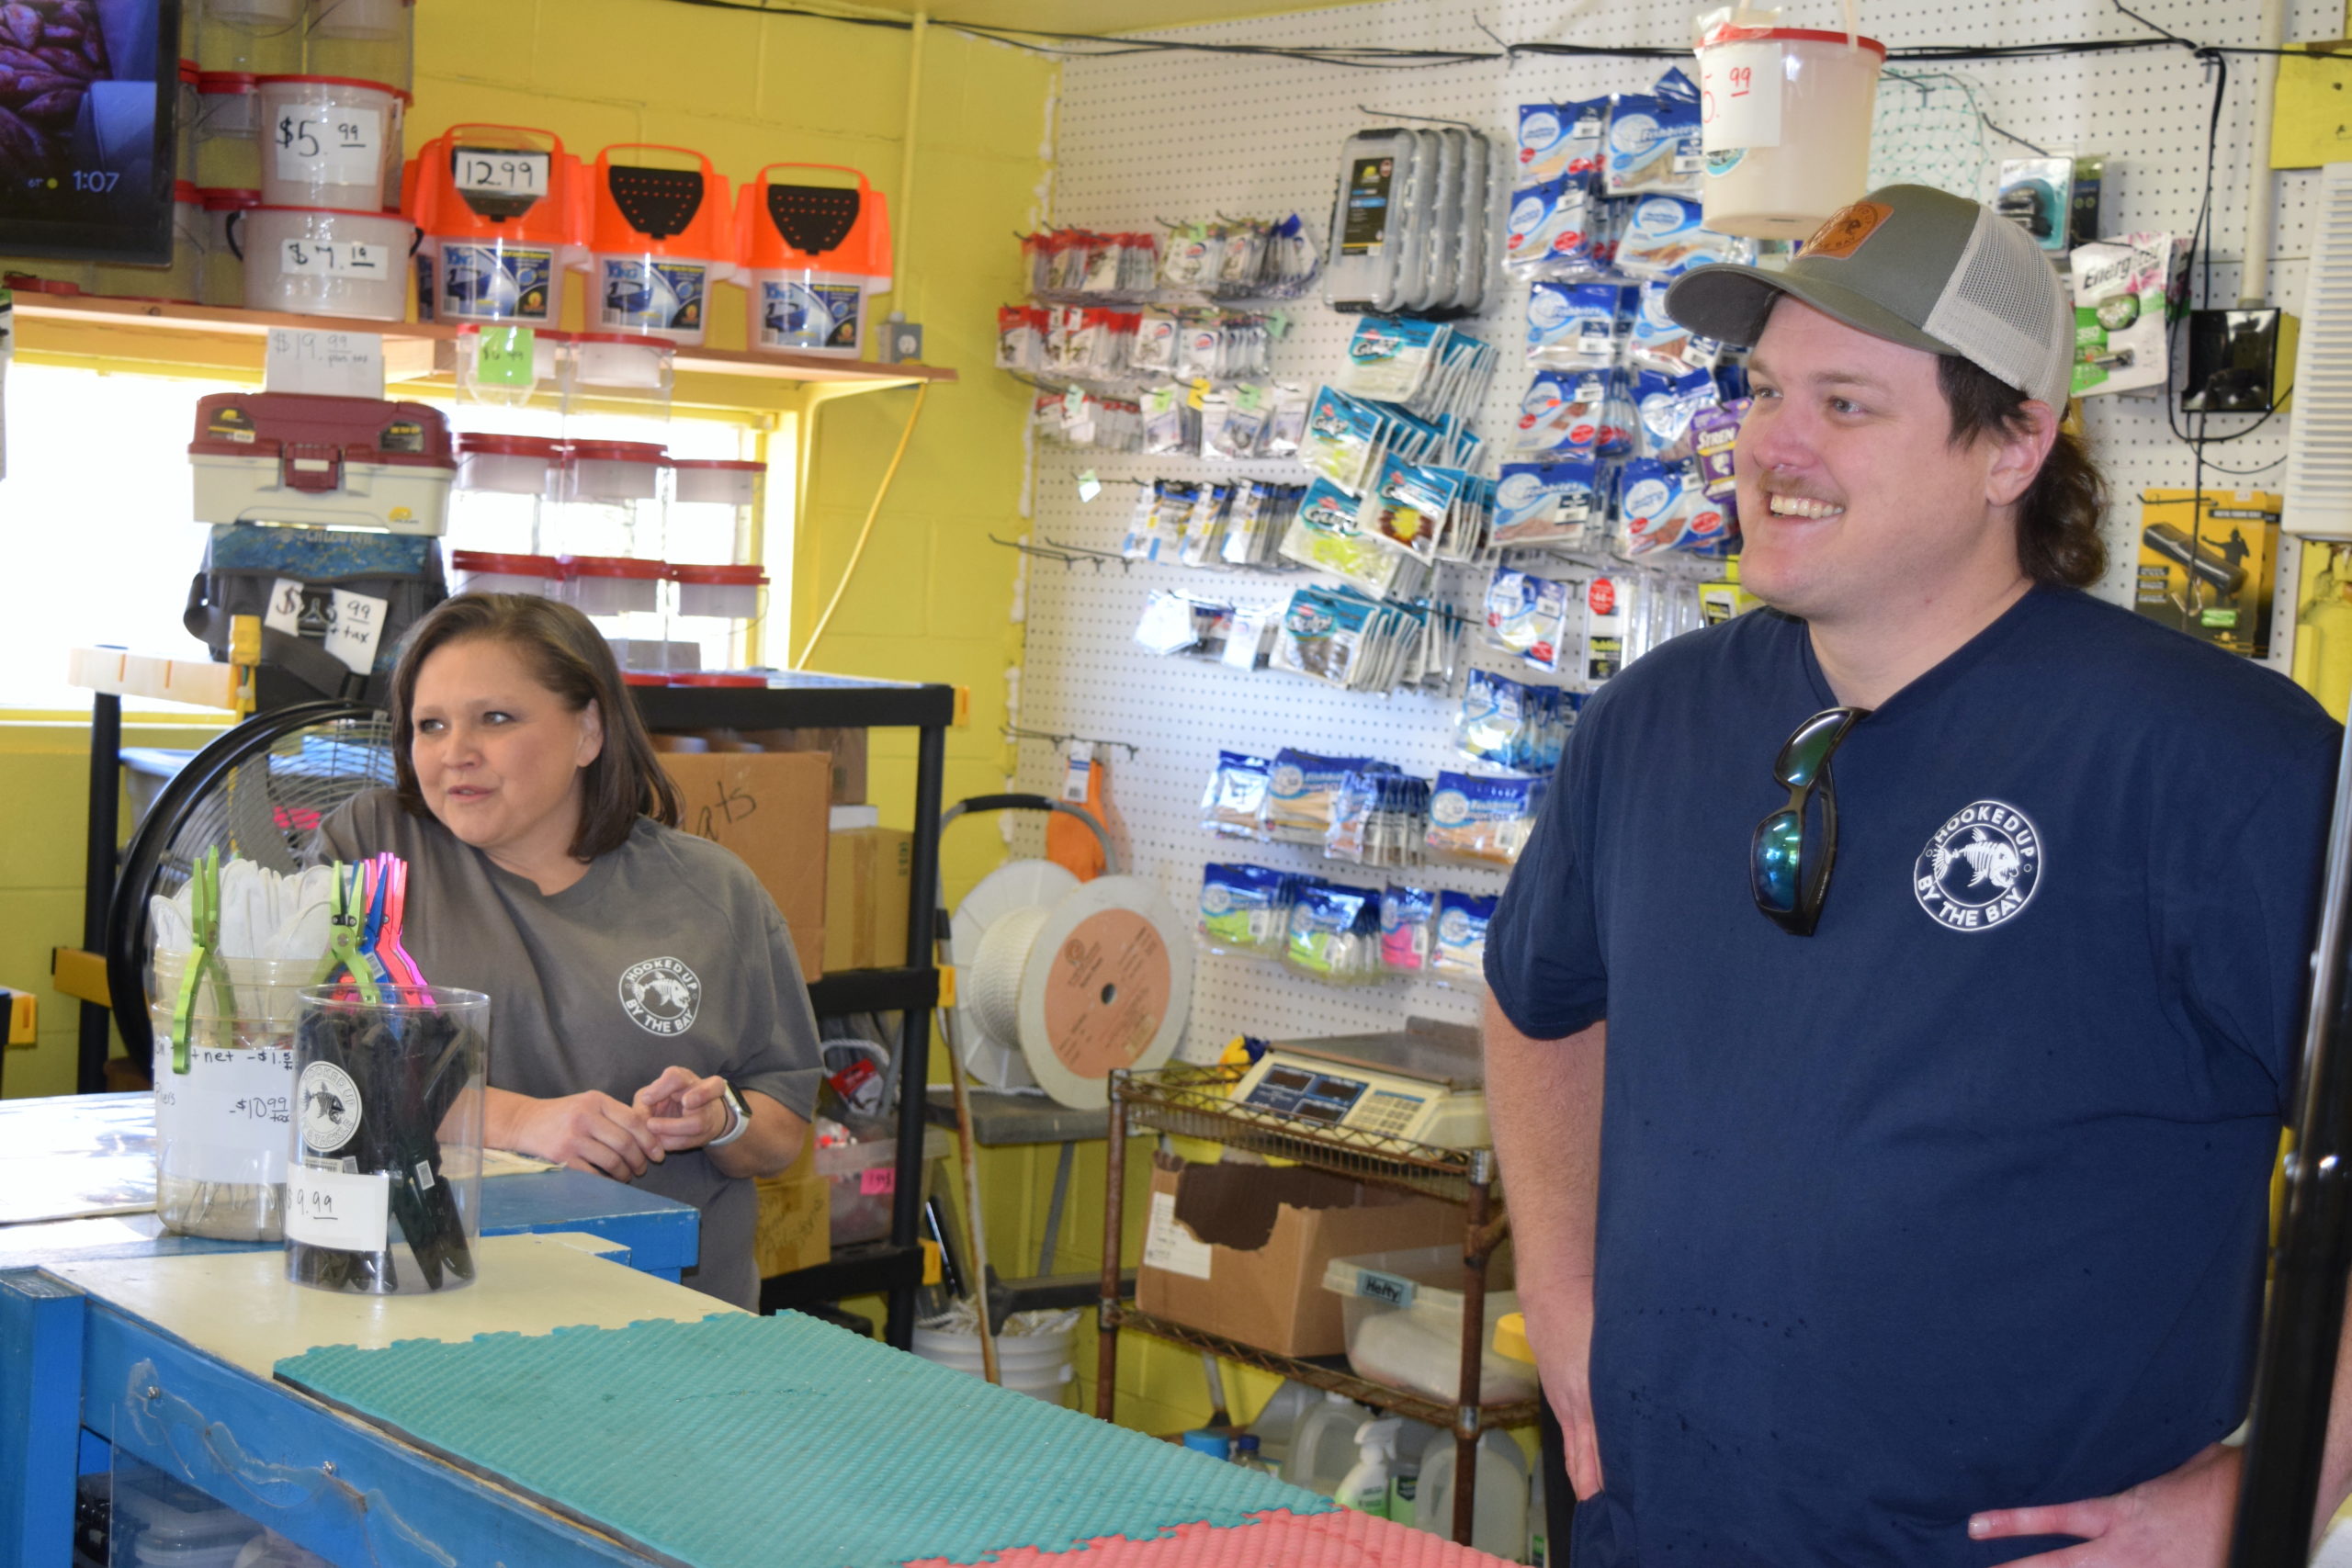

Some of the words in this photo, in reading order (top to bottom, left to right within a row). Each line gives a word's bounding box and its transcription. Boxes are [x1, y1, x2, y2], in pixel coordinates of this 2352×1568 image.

[73, 170, 119, 193] 1:07
[1697, 427, 1736, 450] STREN
[696, 781, 757, 841] ats
[1934, 806, 2019, 842] HOOKED
[2015, 829, 2035, 857] UP
[1917, 874, 1940, 900] BY
[1939, 900, 1979, 927] THE
[1984, 886, 2023, 923] BAY
[626, 959, 683, 981] HOOKED
[682, 972, 698, 990] UP
[625, 998, 644, 1016] BY
[644, 1014, 672, 1033] THE
[673, 1009, 693, 1031] BAY
[1364, 1277, 1401, 1301] Hefty
